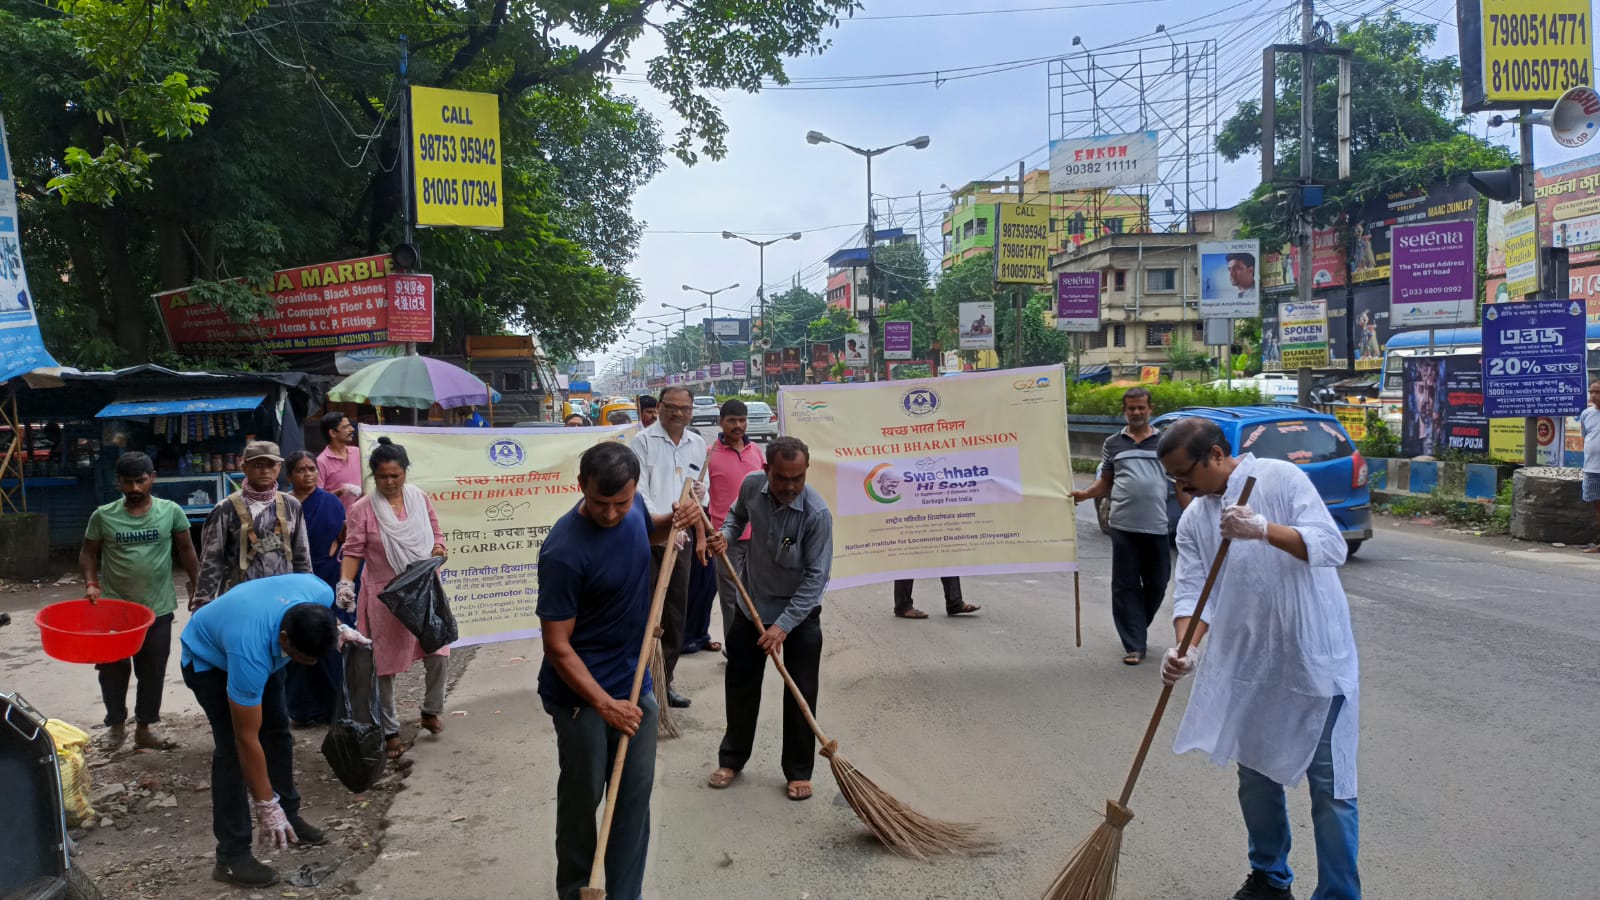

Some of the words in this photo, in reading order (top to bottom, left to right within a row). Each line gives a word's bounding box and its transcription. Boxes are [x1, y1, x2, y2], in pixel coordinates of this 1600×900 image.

[1490, 13, 1586, 46] 7980514771
[1492, 58, 1589, 92] 8100507394
[442, 105, 473, 125] CALL
[420, 133, 456, 162] 98753
[460, 137, 497, 165] 95942
[1065, 162, 1101, 176] 90382
[1105, 160, 1137, 171] 11111
[423, 177, 458, 205] 81005
[462, 180, 498, 207] 07394
[1015, 206, 1035, 217] CALL
[1003, 223, 1046, 239] 9875395942
[1003, 243, 1045, 260] 7980514771
[1505, 236, 1535, 254] Spoken
[1437, 260, 1465, 268] Address
[1509, 249, 1531, 263] English
[1002, 263, 1045, 279] 8100507394
[277, 292, 321, 306] Granites,
[324, 287, 350, 301] Black
[352, 283, 386, 297] Stones,
[287, 305, 338, 321] Company's
[340, 302, 363, 314] Floor
[366, 299, 374, 309] &
[279, 322, 307, 333] Items
[310, 321, 317, 331] &
[342, 315, 376, 331] Fittings
[1284, 324, 1323, 336] SPOKEN
[1284, 348, 1325, 357] DUNLOP
[1490, 357, 1541, 376] 20%
[1489, 388, 1505, 396] 5000
[881, 425, 908, 437] स्वच्छ
[910, 423, 935, 435] भारत
[937, 418, 966, 432] मिशन
[834, 443, 900, 457] SWACHCH
[903, 438, 957, 453] BHARAT
[961, 432, 1019, 447] MISSION
[1449, 436, 1464, 448] THIS
[1464, 437, 1483, 449] PUJA
[454, 475, 490, 488] स्वच्छ
[495, 473, 525, 486] भारत
[527, 470, 561, 483] मिशन
[903, 465, 989, 483] Swachhata
[427, 488, 482, 501] ACHCH
[487, 485, 541, 499] BHARAT
[545, 483, 583, 496] MISSI
[916, 481, 934, 491] Hi
[938, 480, 977, 490] Seva
[115, 529, 159, 544] RUNNER
[452, 529, 481, 541] विषय
[460, 540, 524, 555] GARBAGE
[527, 538, 544, 549] FR
[845, 542, 870, 551] National
[461, 565, 498, 577] गतिशील
[501, 562, 539, 574] दिव्यांगज
[454, 594, 468, 602] for
[471, 589, 522, 600] Locomotor
